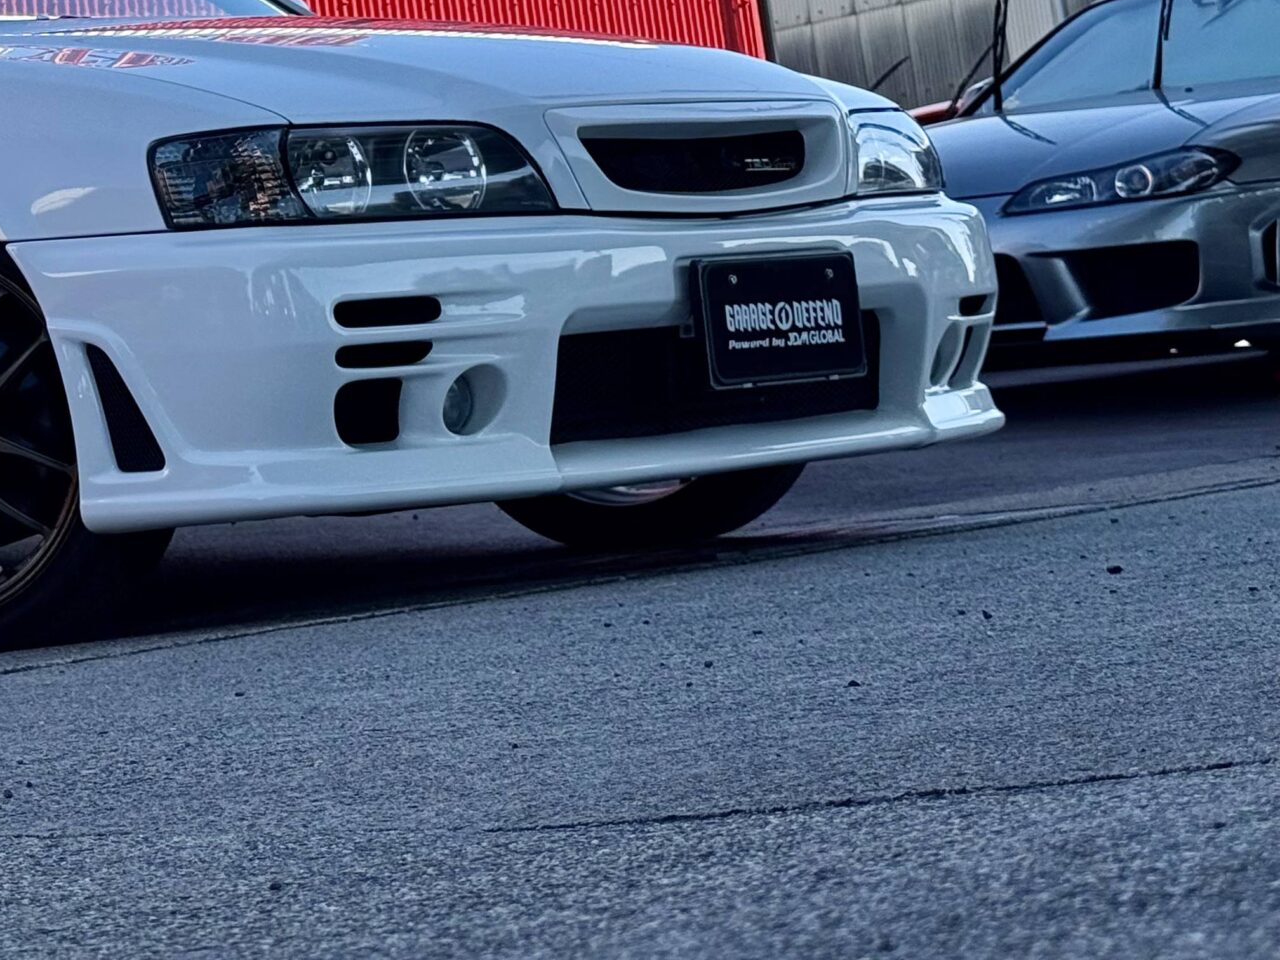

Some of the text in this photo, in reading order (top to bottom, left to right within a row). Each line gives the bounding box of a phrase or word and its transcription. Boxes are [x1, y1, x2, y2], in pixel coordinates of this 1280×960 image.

[724, 298, 842, 332] GARAGE DEFEND
[772, 337, 785, 347] by
